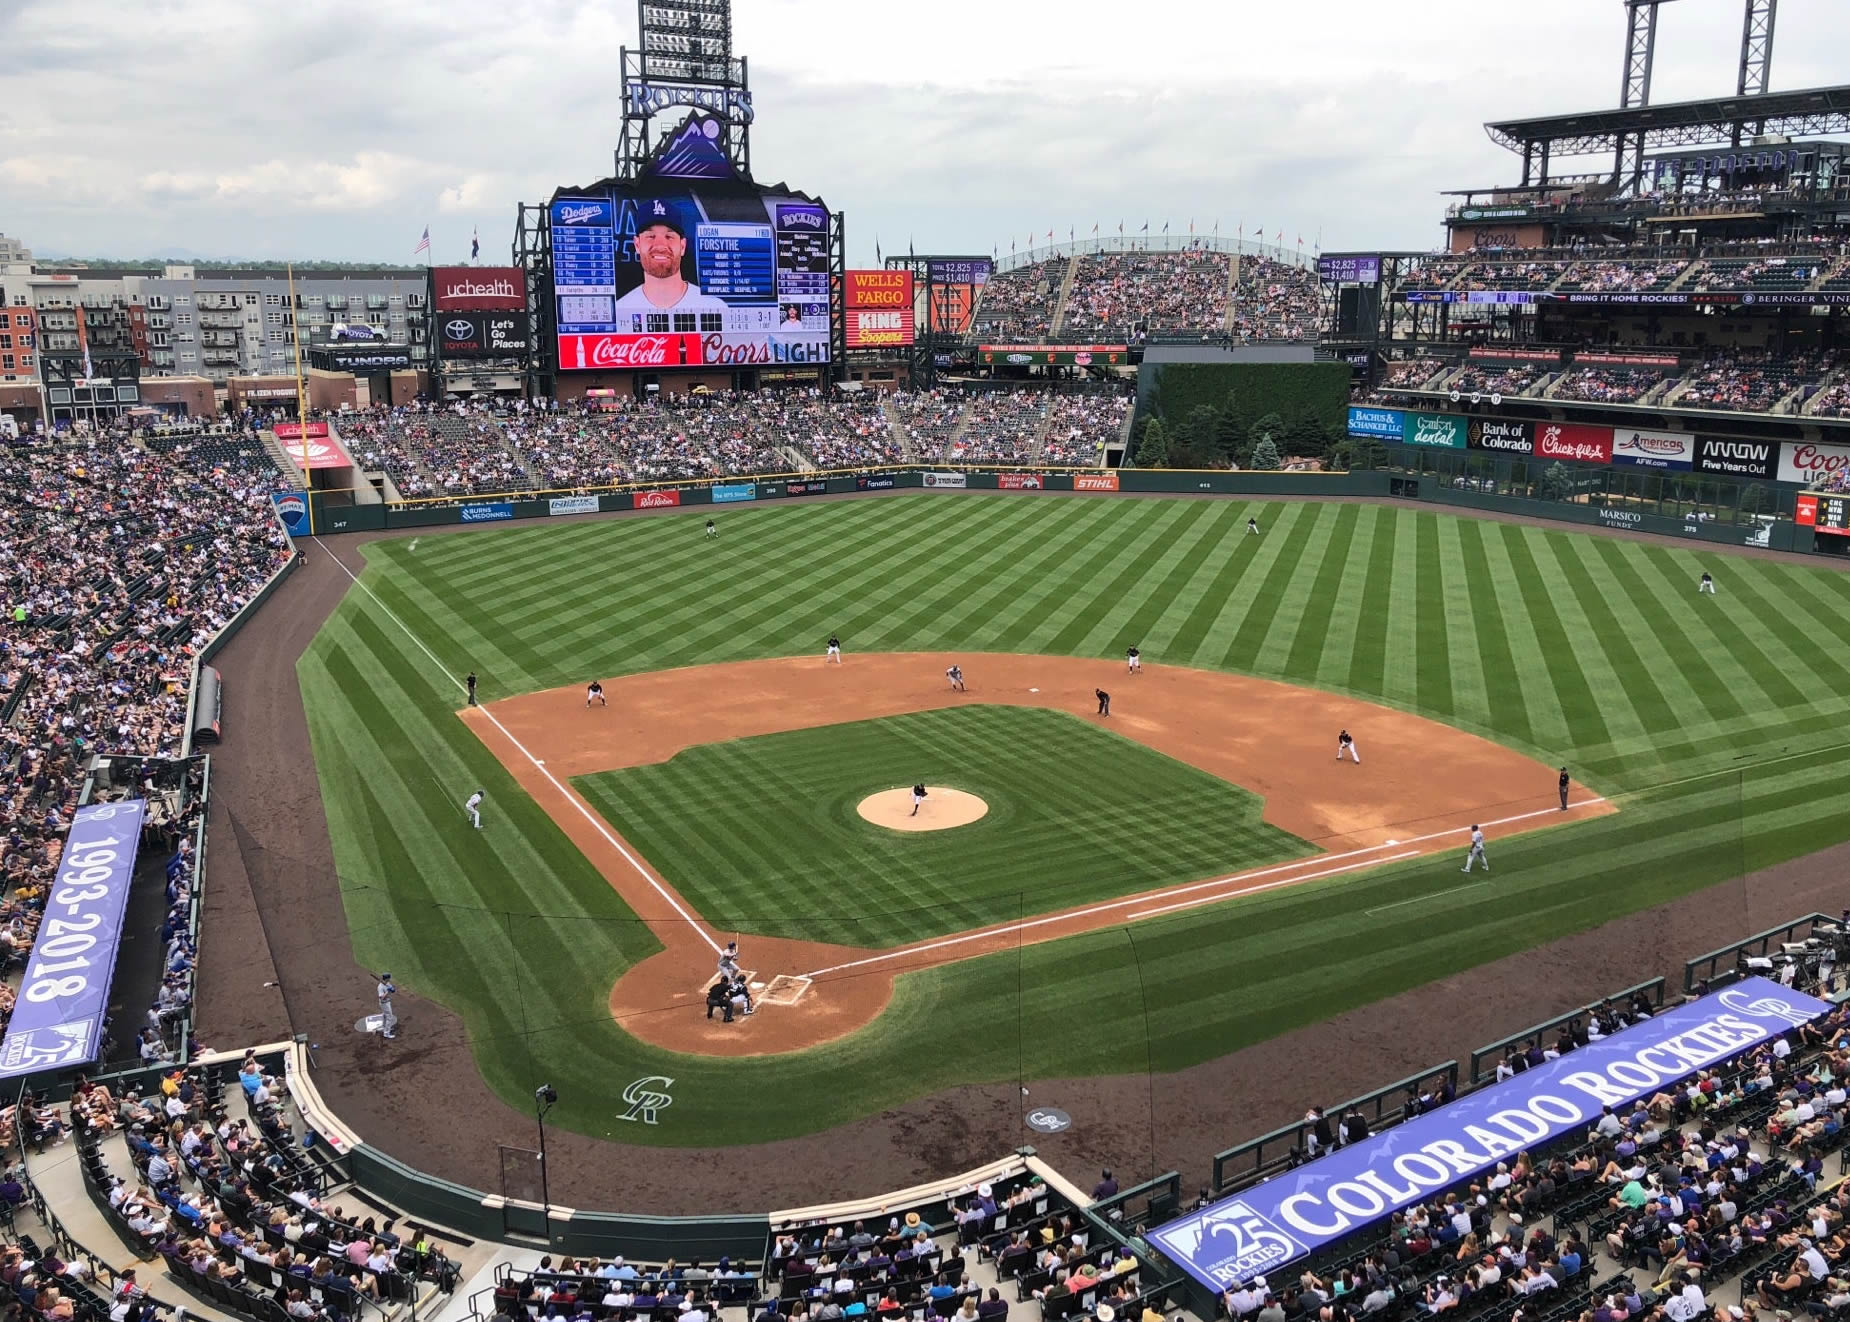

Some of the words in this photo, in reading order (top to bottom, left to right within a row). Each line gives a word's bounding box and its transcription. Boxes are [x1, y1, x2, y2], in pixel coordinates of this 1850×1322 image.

[626, 84, 755, 122] ROCKIES
[560, 204, 603, 225] Dodgers
[782, 212, 823, 228] ROCKIES
[699, 227, 719, 237] LOGAN
[1473, 226, 1517, 248] Coors
[699, 238, 740, 251] FORSYTHE
[946, 262, 971, 273] $2,825
[1331, 259, 1357, 271] $2,825
[854, 274, 904, 287] WELLS
[946, 272, 970, 283] $1,410
[1330, 270, 1355, 281] $1,410
[447, 279, 514, 297] uchealth
[856, 291, 904, 304] FARGO
[1758, 295, 1816, 303] BERINGER
[491, 320, 514, 329] Let's
[858, 312, 902, 329] KING
[345, 329, 374, 340] TOYOTA
[491, 329, 506, 339] Go
[858, 329, 903, 346] Soopers
[444, 342, 479, 350] TOYOTA
[492, 339, 526, 349] Places
[593, 336, 669, 365] Coca-Cola
[702, 332, 771, 365] Coors
[773, 342, 830, 363] LIGHT
[335, 355, 409, 367] TUNDRA
[934, 354, 951, 362] PLATTE
[1347, 355, 1368, 363] PLATTE
[1355, 410, 1386, 422] BACHUS
[1348, 418, 1388, 431] SCHANKER
[1388, 424, 1403, 432] LLC
[1417, 415, 1453, 432] Comfort
[1483, 422, 1510, 436] Bank
[1511, 423, 1524, 437] of
[1414, 428, 1456, 446] dental
[1482, 435, 1532, 451] Colorado
[1542, 425, 1604, 459] Chick-fil-A
[1702, 441, 1769, 461] ARROW
[1635, 458, 1668, 468] AFW.com
[1702, 459, 1721, 470] Five
[1722, 462, 1748, 472] Years
[1748, 463, 1766, 474] Out
[866, 479, 893, 488] Fanatics
[1077, 479, 1114, 489] STIHL
[640, 497, 654, 507] Red
[654, 497, 673, 506] Robin
[469, 507, 492, 515] BURNS
[1599, 509, 1641, 522] MARSICO
[1606, 520, 1633, 529] FUNDS
[1683, 525, 1697, 533] 375
[25, 835, 120, 1004] 1993-2018
[1279, 1094, 1583, 1237] COLORADO
[1559, 1013, 1768, 1106] ROCKIES
[1210, 1217, 1295, 1262] 25
[1206, 1255, 1237, 1272] COLORADO
[1210, 1242, 1286, 1283] ROCKIES
[1240, 1258, 1280, 1280] 1993-2018
